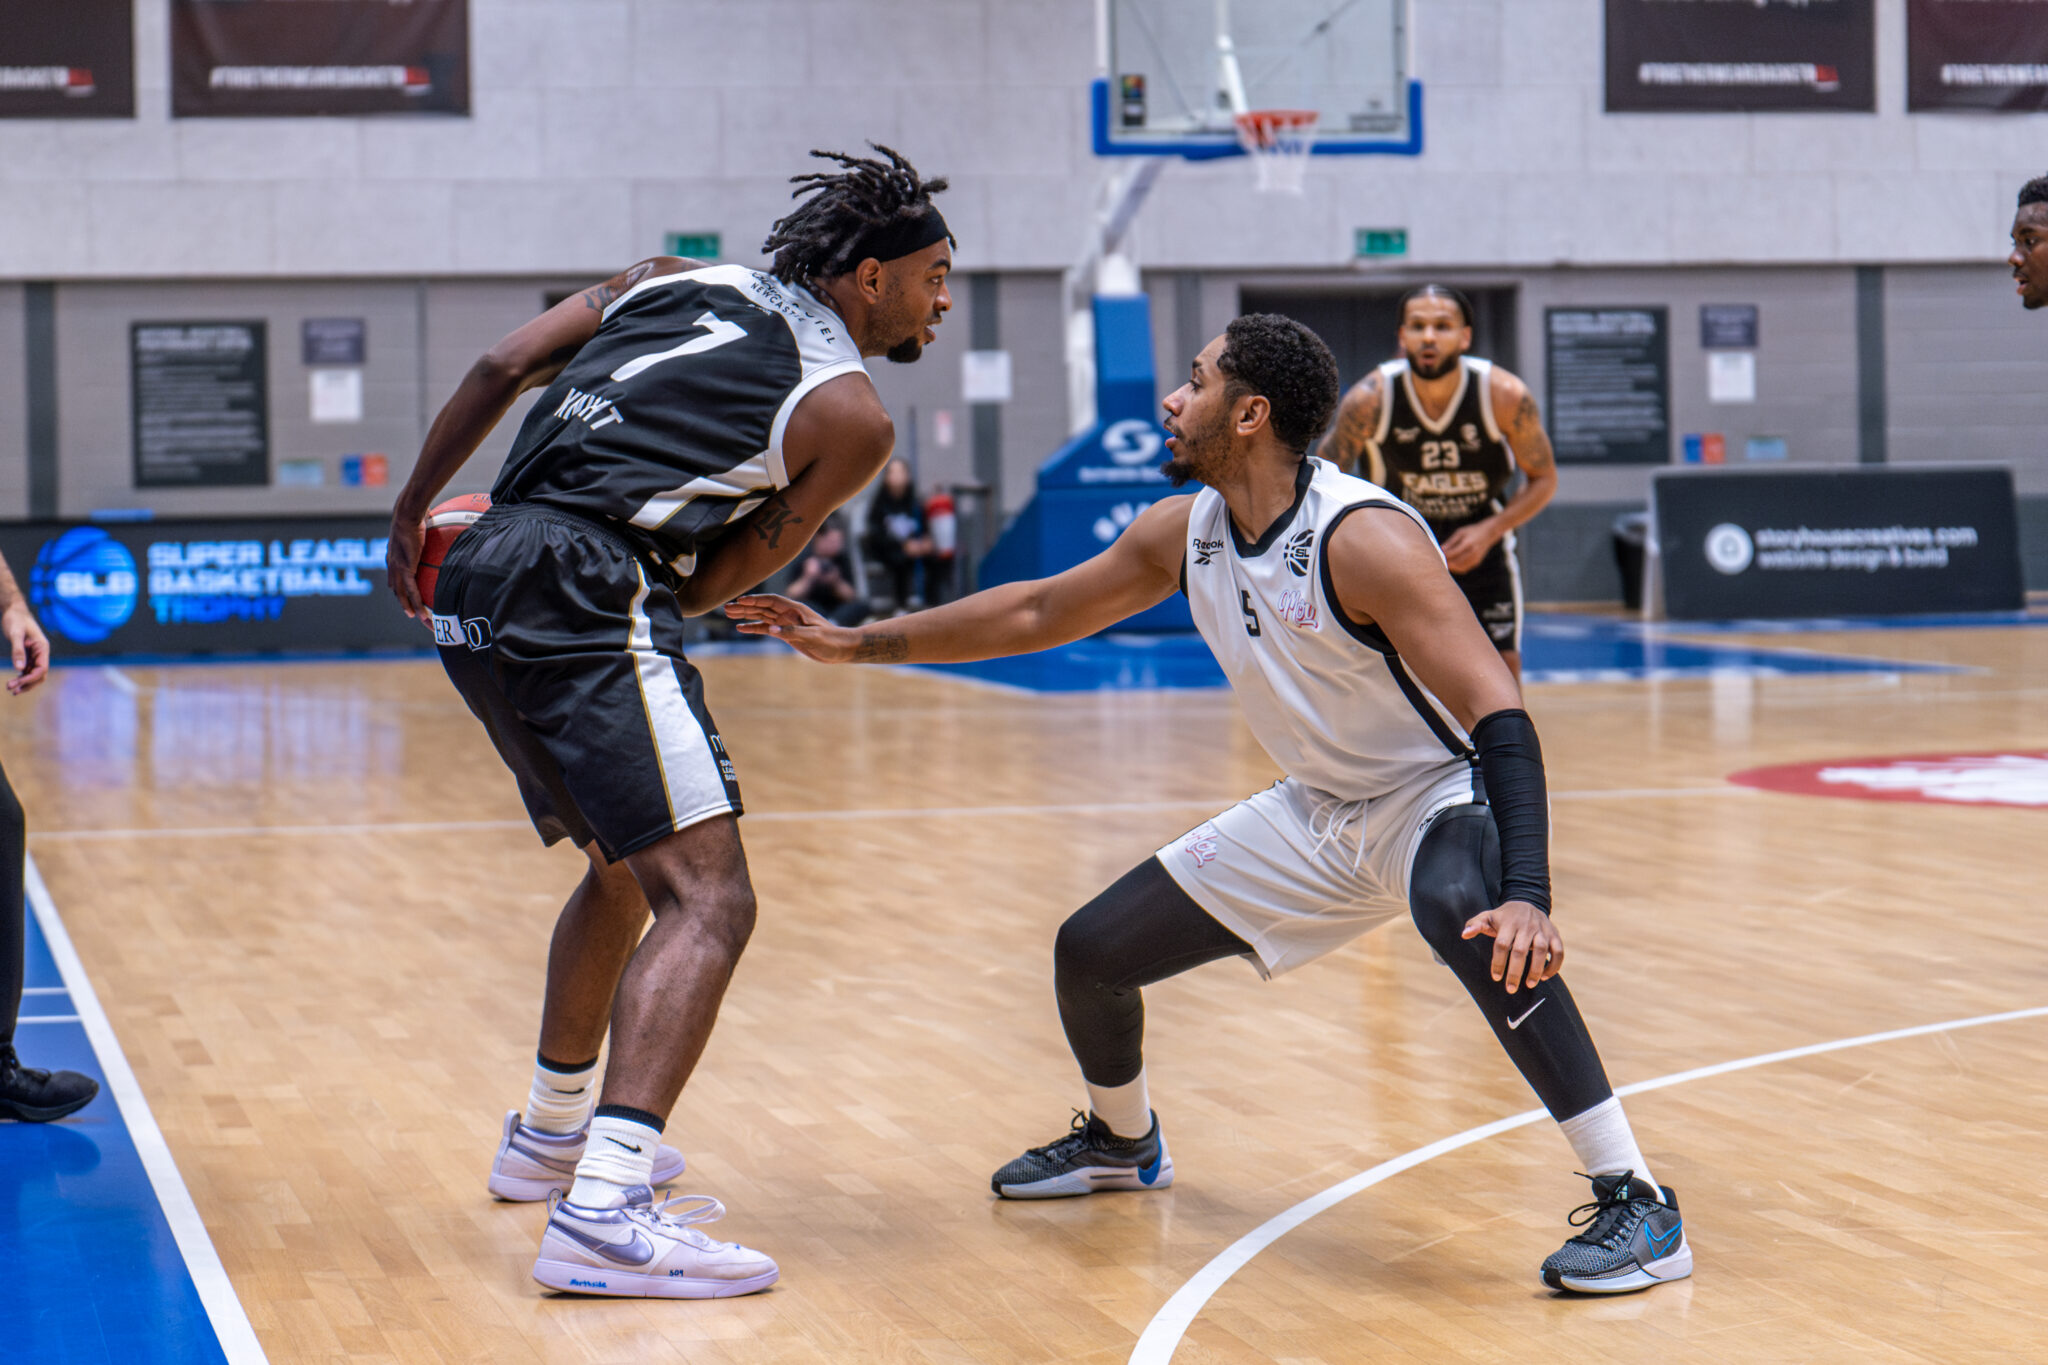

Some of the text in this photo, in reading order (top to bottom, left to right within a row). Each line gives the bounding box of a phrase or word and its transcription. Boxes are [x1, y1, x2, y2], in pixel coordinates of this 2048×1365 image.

[610, 311, 749, 382] 7
[1420, 440, 1461, 470] 23
[1400, 470, 1488, 494] EAGLES
[147, 540, 264, 567] SUPER
[1192, 538, 1224, 550] Reeok
[148, 566, 371, 596] BASKETBALL
[1241, 589, 1261, 637] 5
